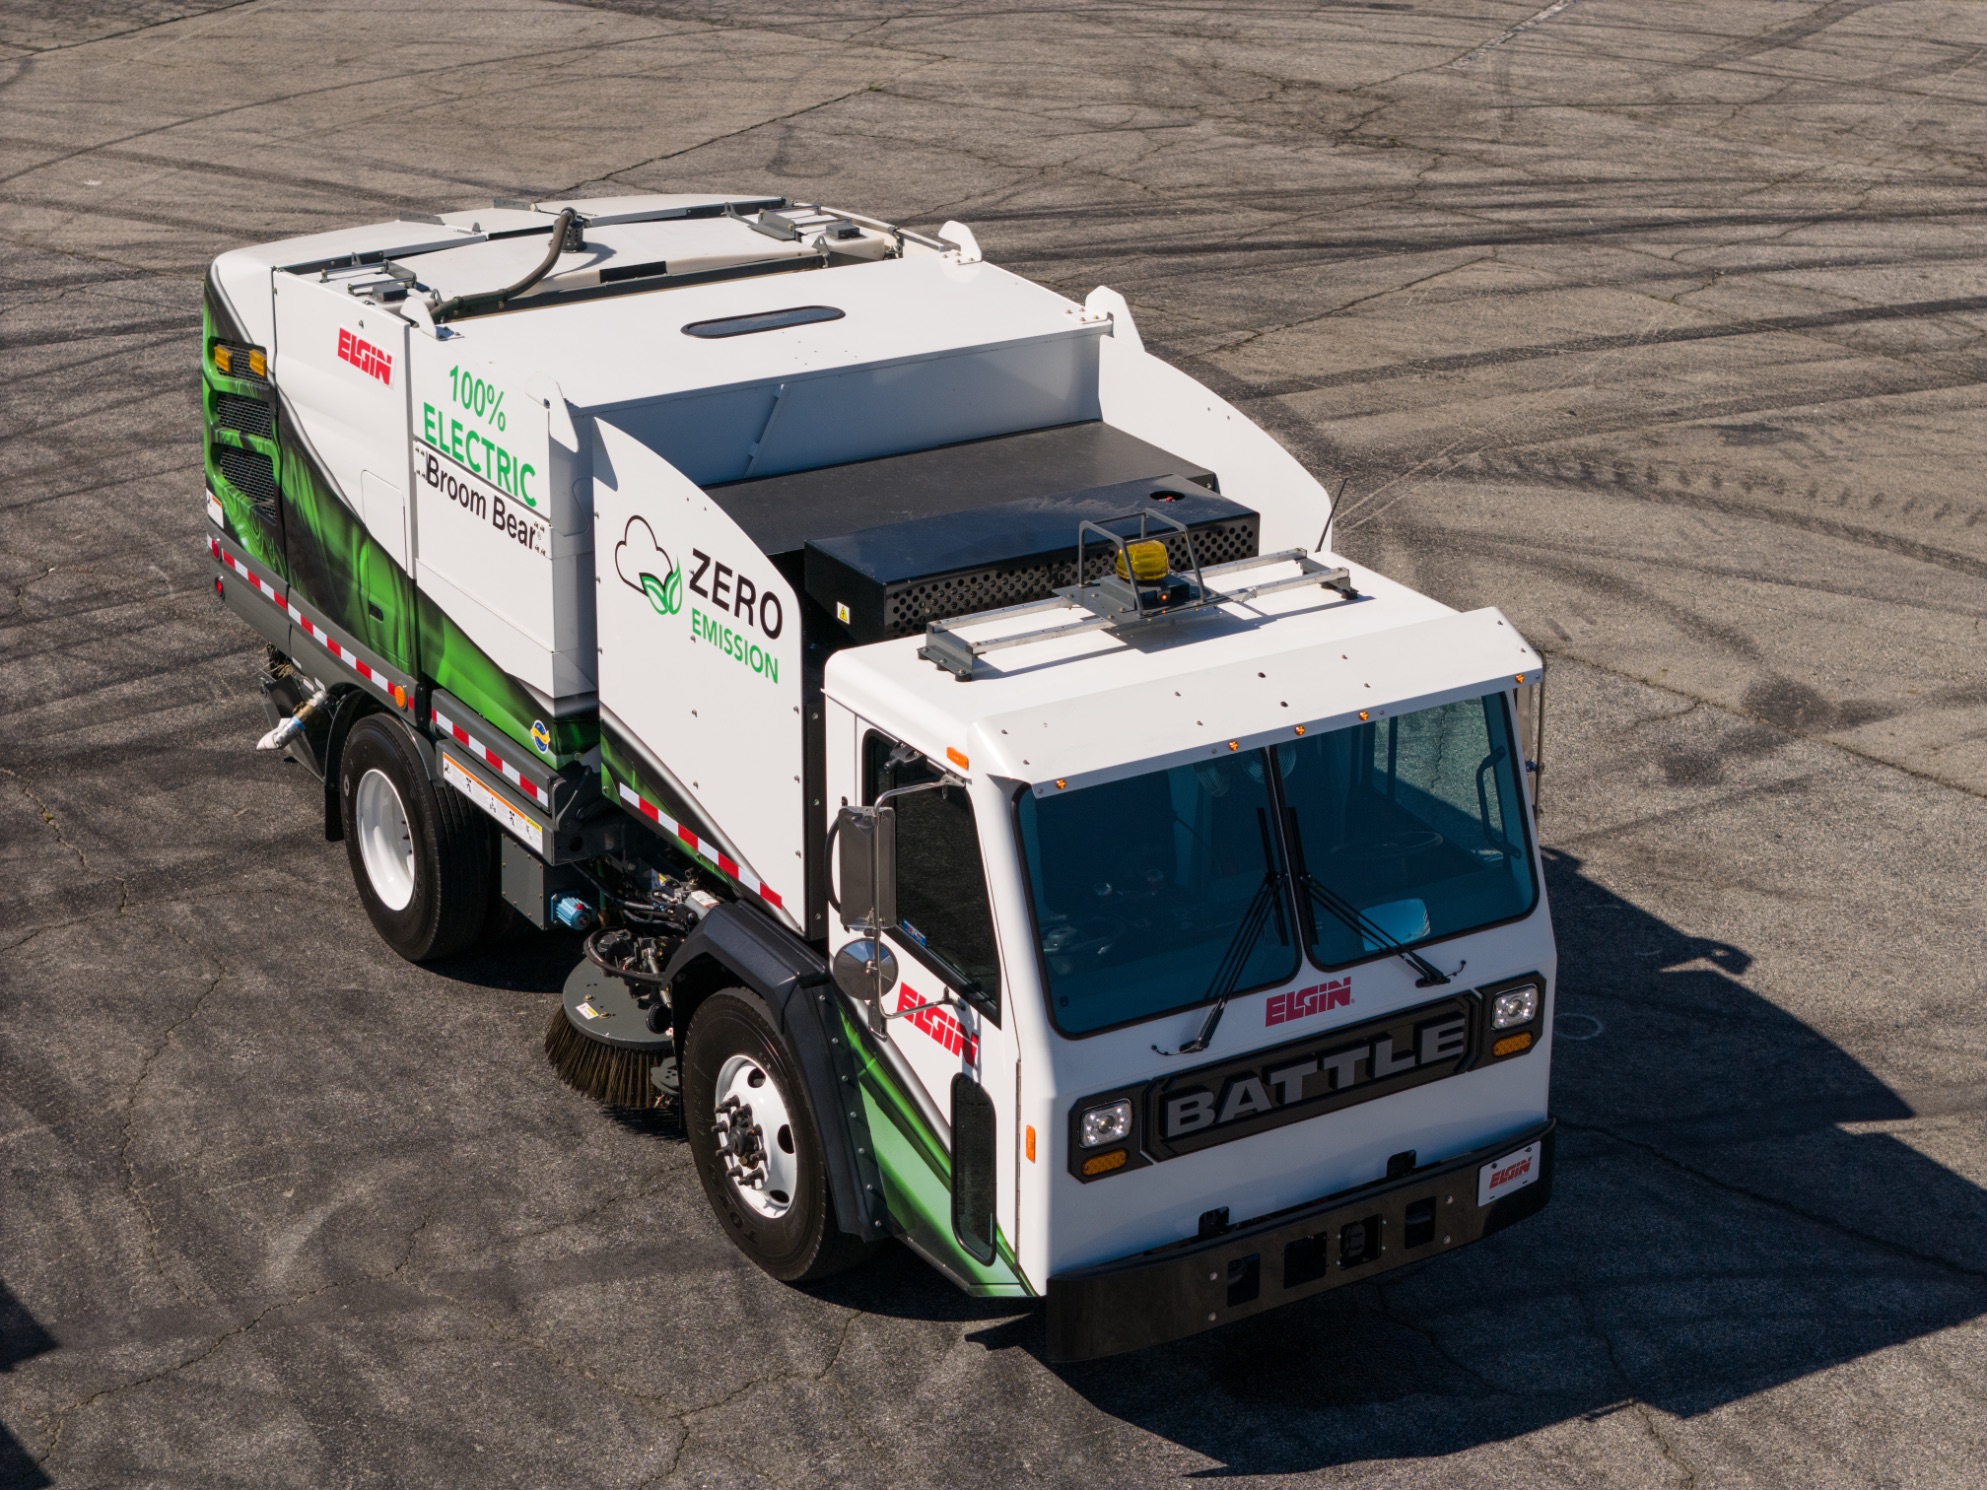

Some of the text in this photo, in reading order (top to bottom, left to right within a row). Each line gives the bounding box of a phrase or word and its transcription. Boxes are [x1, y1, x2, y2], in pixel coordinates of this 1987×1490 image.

[337, 327, 393, 386] ELGIN
[449, 364, 506, 432] 100%
[423, 401, 537, 508] ELECTRIC
[427, 453, 487, 520] Broom
[689, 547, 783, 640] ZERO
[691, 607, 779, 685] EMISSION
[896, 981, 980, 1068] ELGIN
[1265, 976, 1352, 1027] ELGIN
[1165, 1013, 1466, 1138] BATTLE
[1488, 1155, 1533, 1190] ELGIN
